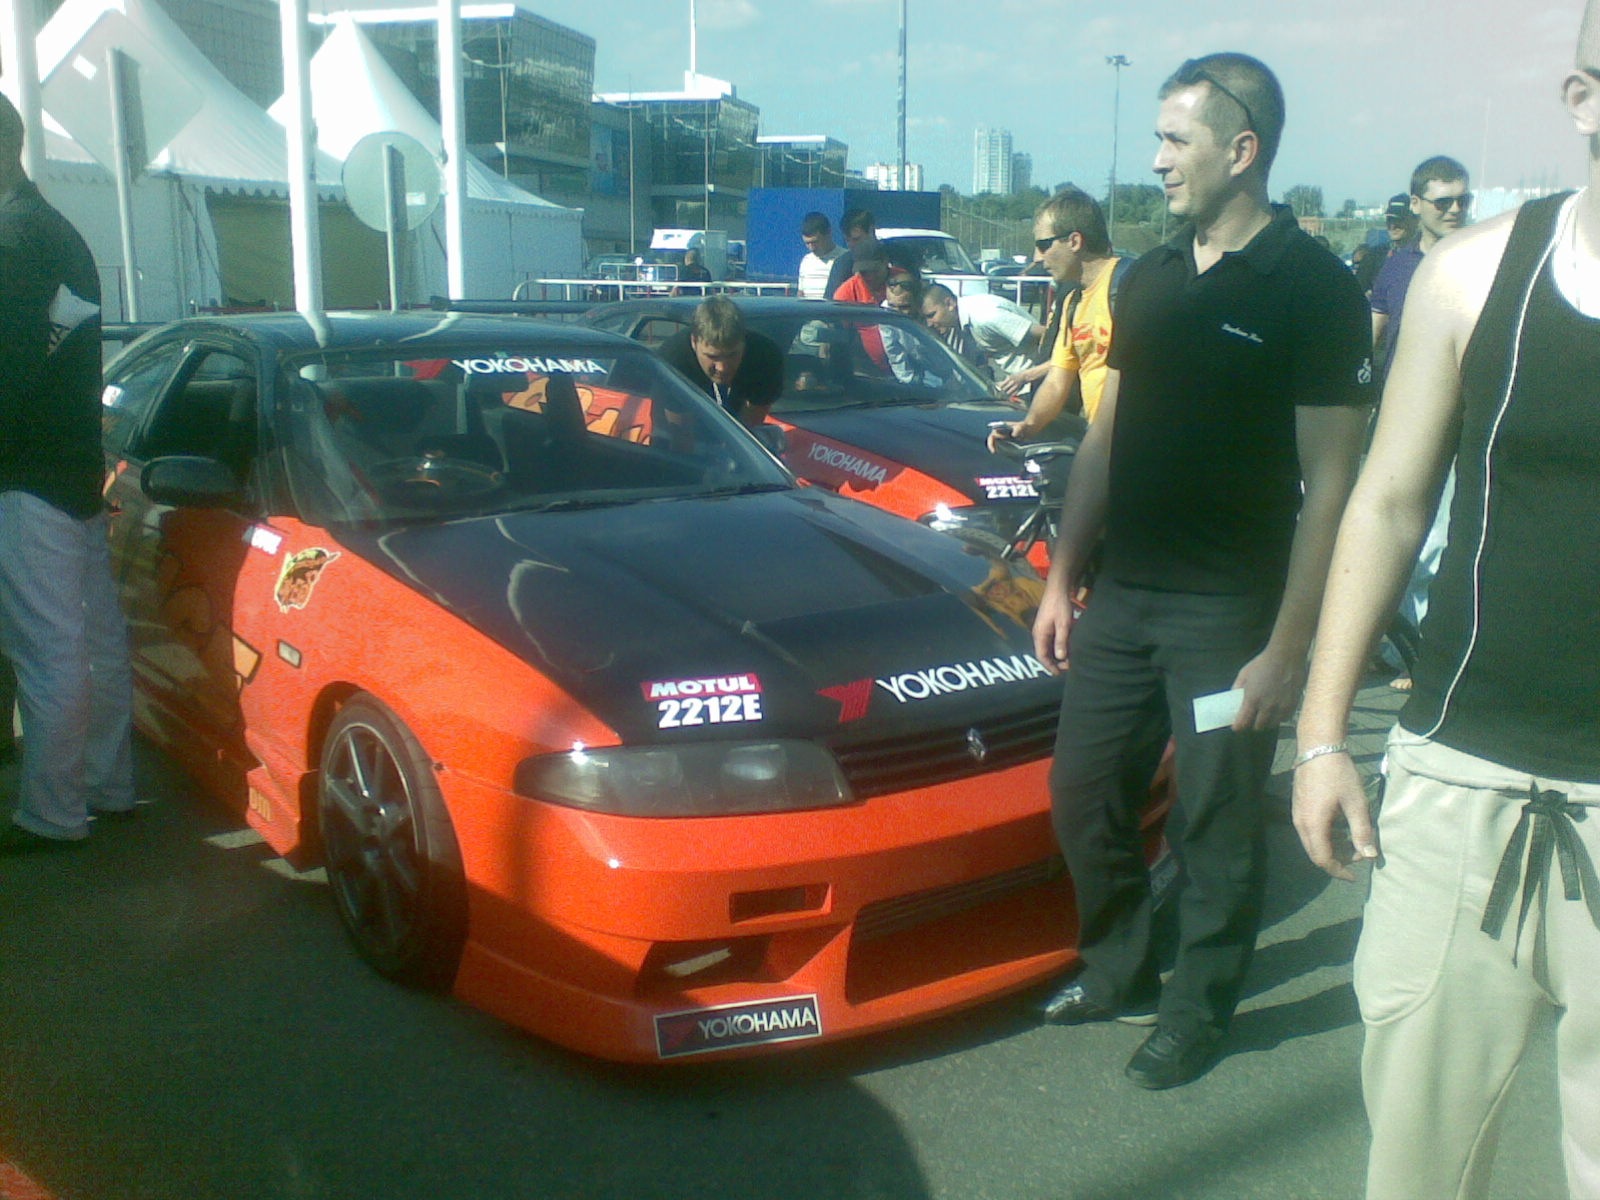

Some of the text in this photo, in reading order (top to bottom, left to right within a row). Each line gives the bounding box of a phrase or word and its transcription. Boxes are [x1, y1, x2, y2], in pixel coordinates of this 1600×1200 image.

[451, 358, 608, 375] YOKOHAMA
[808, 442, 888, 485] YOKOHAMA
[650, 676, 755, 698] MOTUL
[875, 654, 1053, 703] YOKOHAMA
[658, 693, 763, 729] 2212E
[698, 1007, 816, 1040] YOKOHAMA
